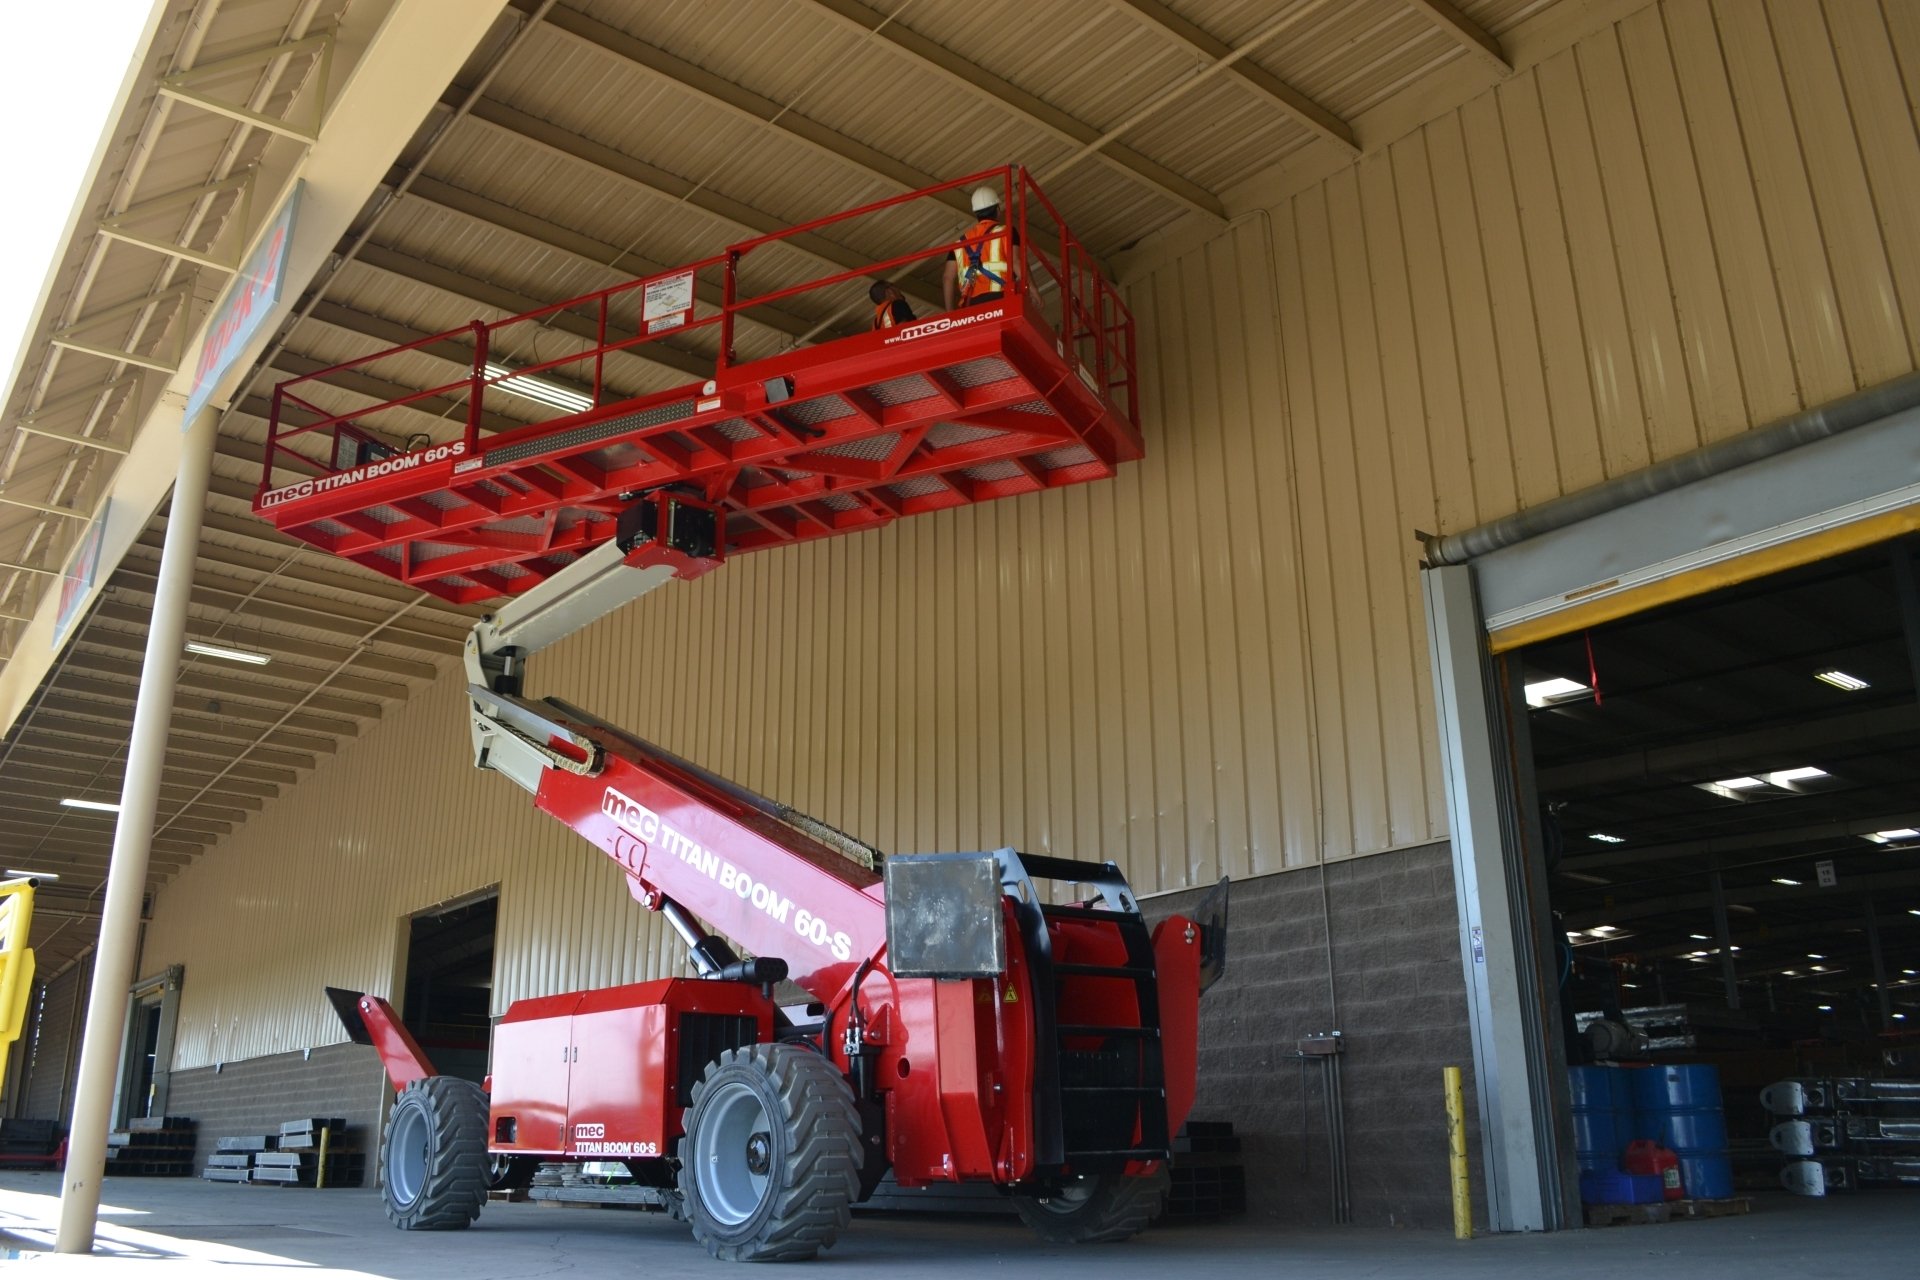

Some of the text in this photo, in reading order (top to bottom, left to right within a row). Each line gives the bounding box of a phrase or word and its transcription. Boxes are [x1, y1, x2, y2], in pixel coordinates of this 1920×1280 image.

[262, 480, 313, 508] mec
[315, 468, 364, 491] TITAN
[425, 442, 465, 462] 60-S
[602, 786, 659, 844] mec
[661, 824, 719, 880] TITAN
[794, 908, 852, 961] 60-S
[575, 1142, 601, 1153] TITAN
[633, 1142, 657, 1154] 60-S
[576, 1124, 604, 1138] mec
